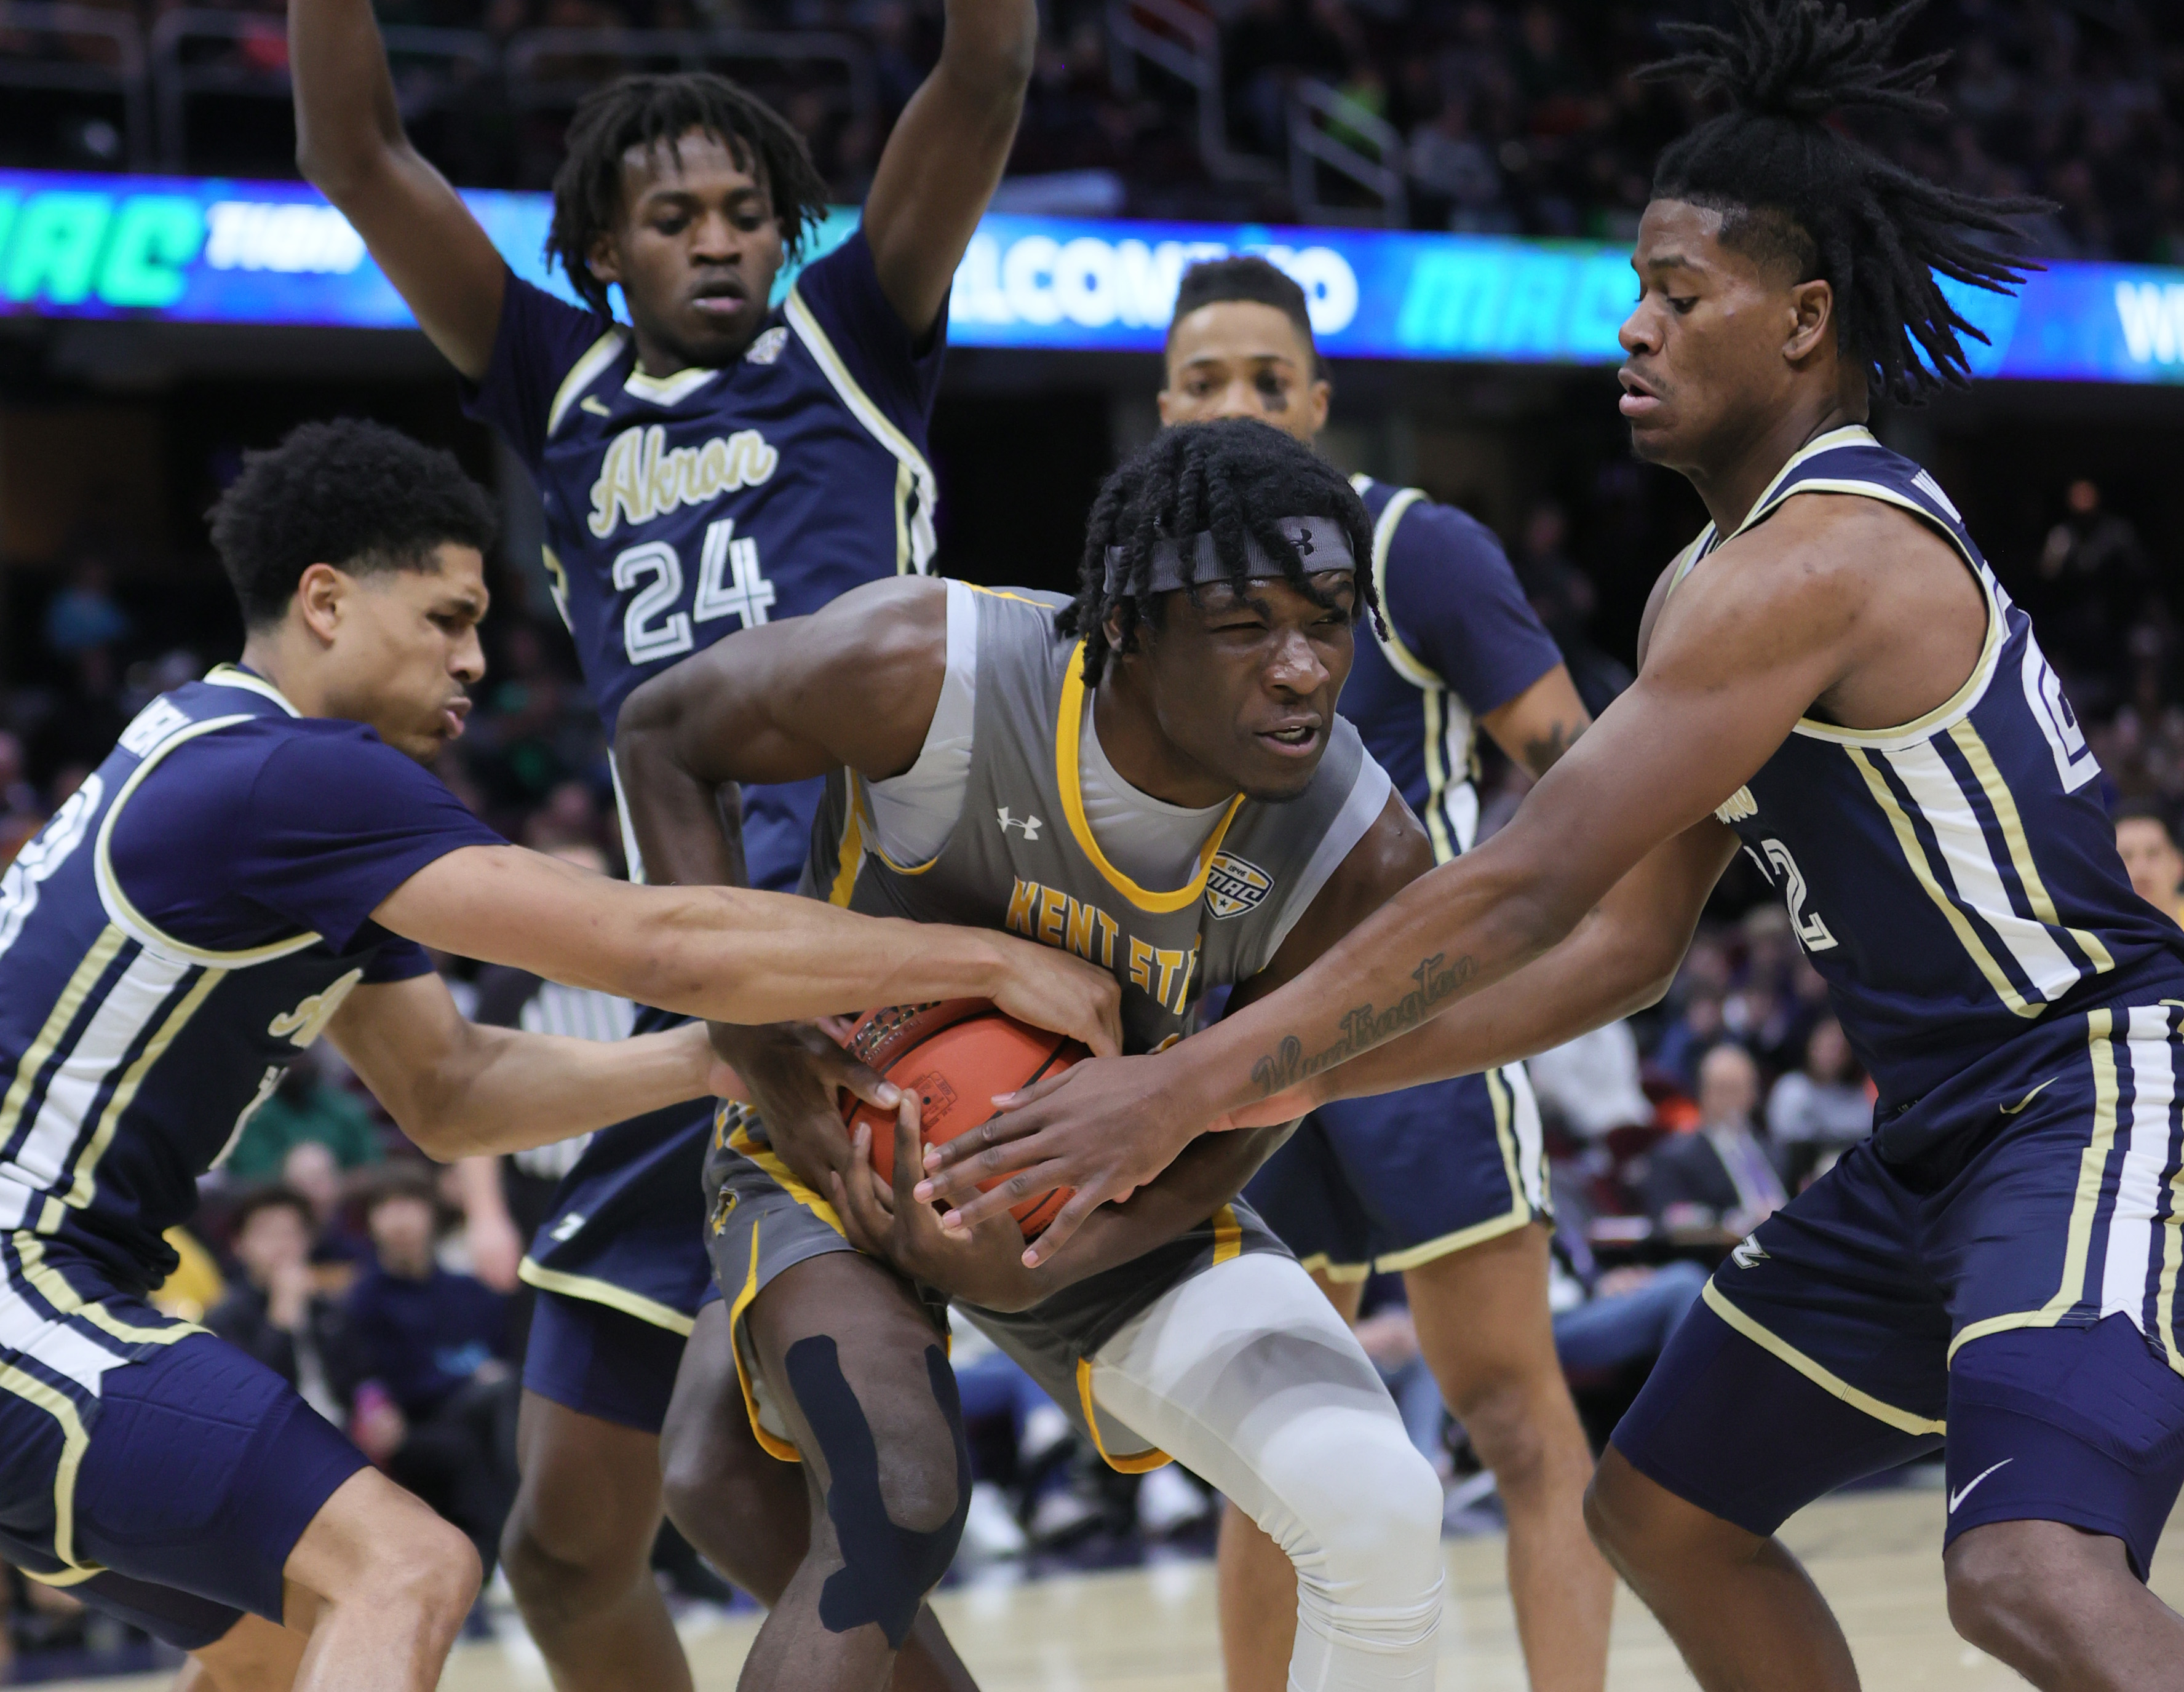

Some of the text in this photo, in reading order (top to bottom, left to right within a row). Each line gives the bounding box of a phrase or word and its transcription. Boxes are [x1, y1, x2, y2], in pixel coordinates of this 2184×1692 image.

[0, 189, 205, 308] AC
[587, 424, 779, 539] Akron
[613, 518, 776, 665] 24
[1006, 876, 1118, 969] KENT
[1207, 869, 1262, 904] MAC
